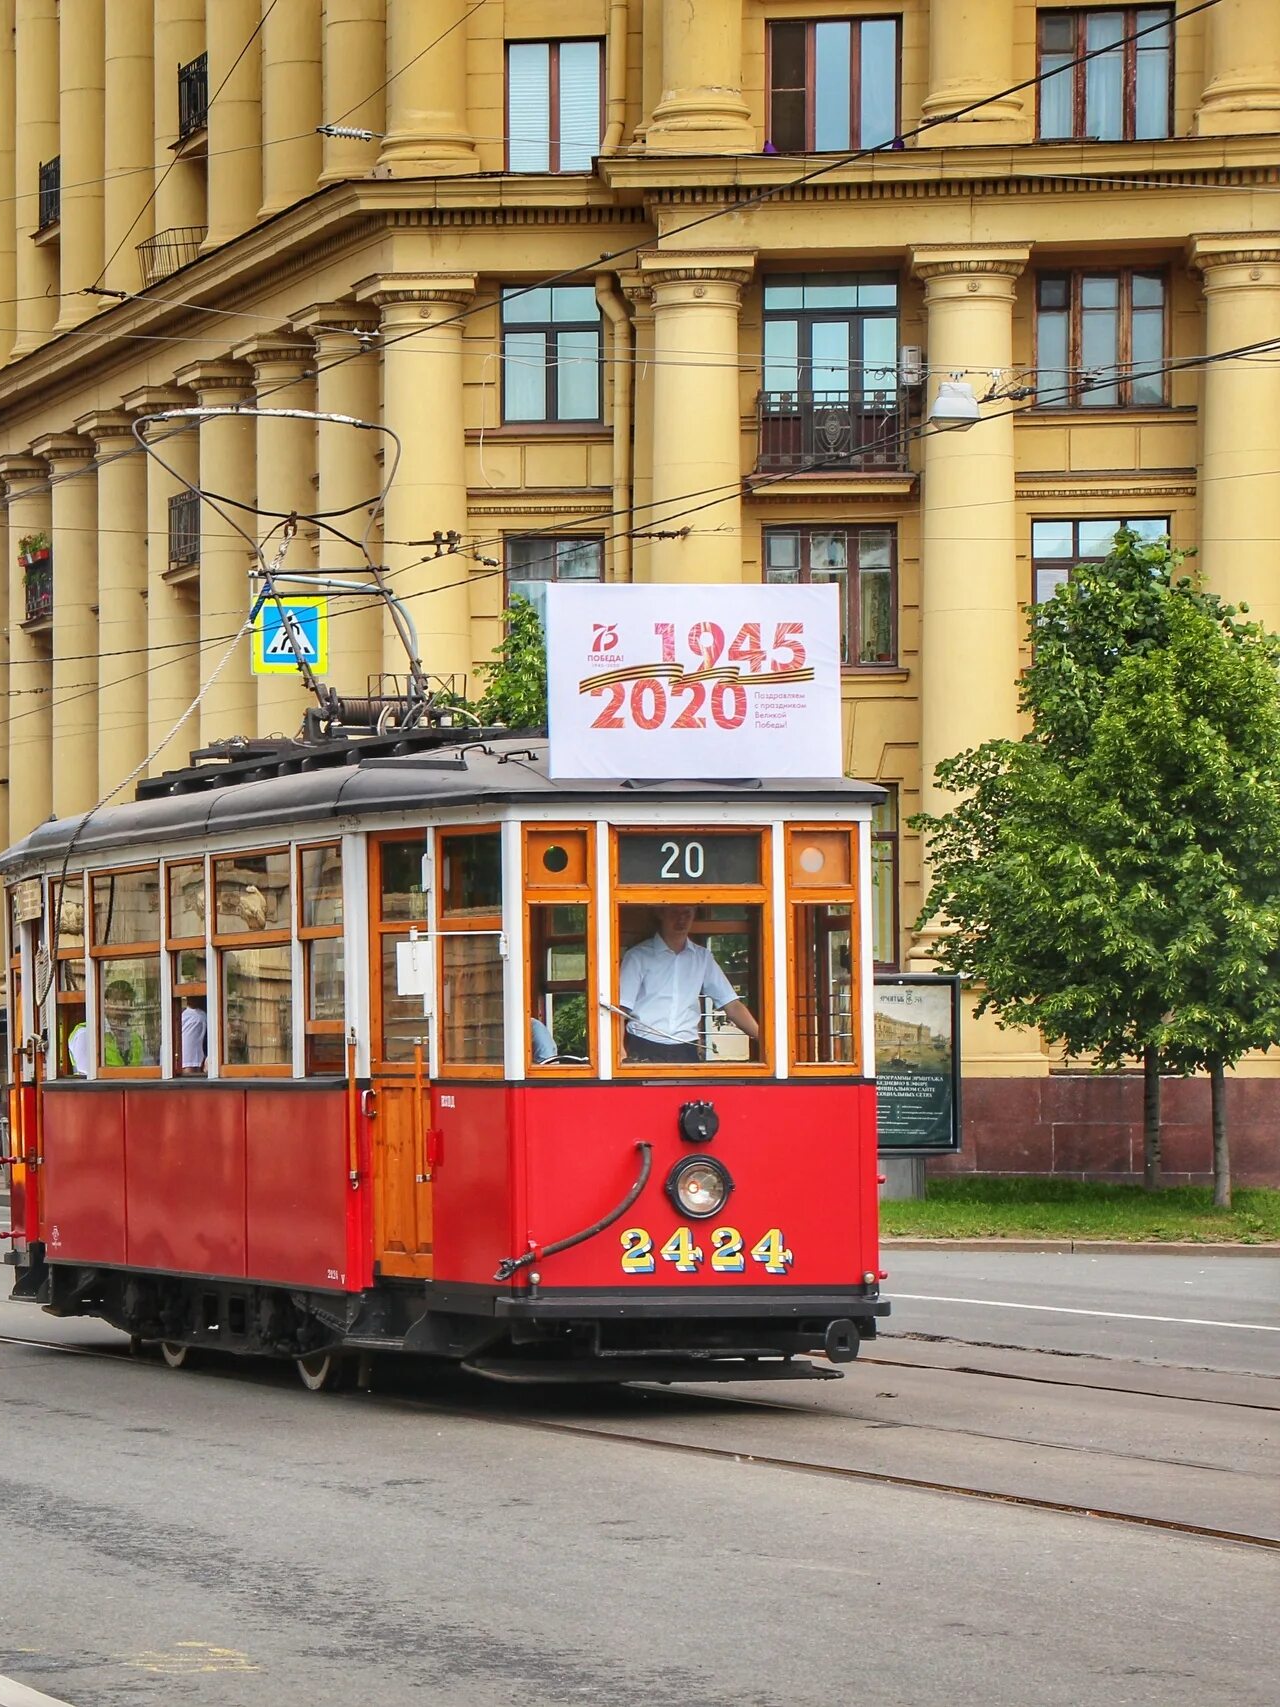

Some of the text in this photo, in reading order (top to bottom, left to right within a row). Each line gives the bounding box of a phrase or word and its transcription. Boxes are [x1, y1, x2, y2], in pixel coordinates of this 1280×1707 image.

[592, 623, 618, 652] 75
[654, 621, 807, 673] 1945
[588, 679, 748, 730] 2020
[754, 691, 806, 700] Поздравляем
[754, 711, 787, 719] Великой
[754, 721, 788, 729] Победы!
[661, 841, 704, 878] 20
[620, 1226, 794, 1274] 2424
